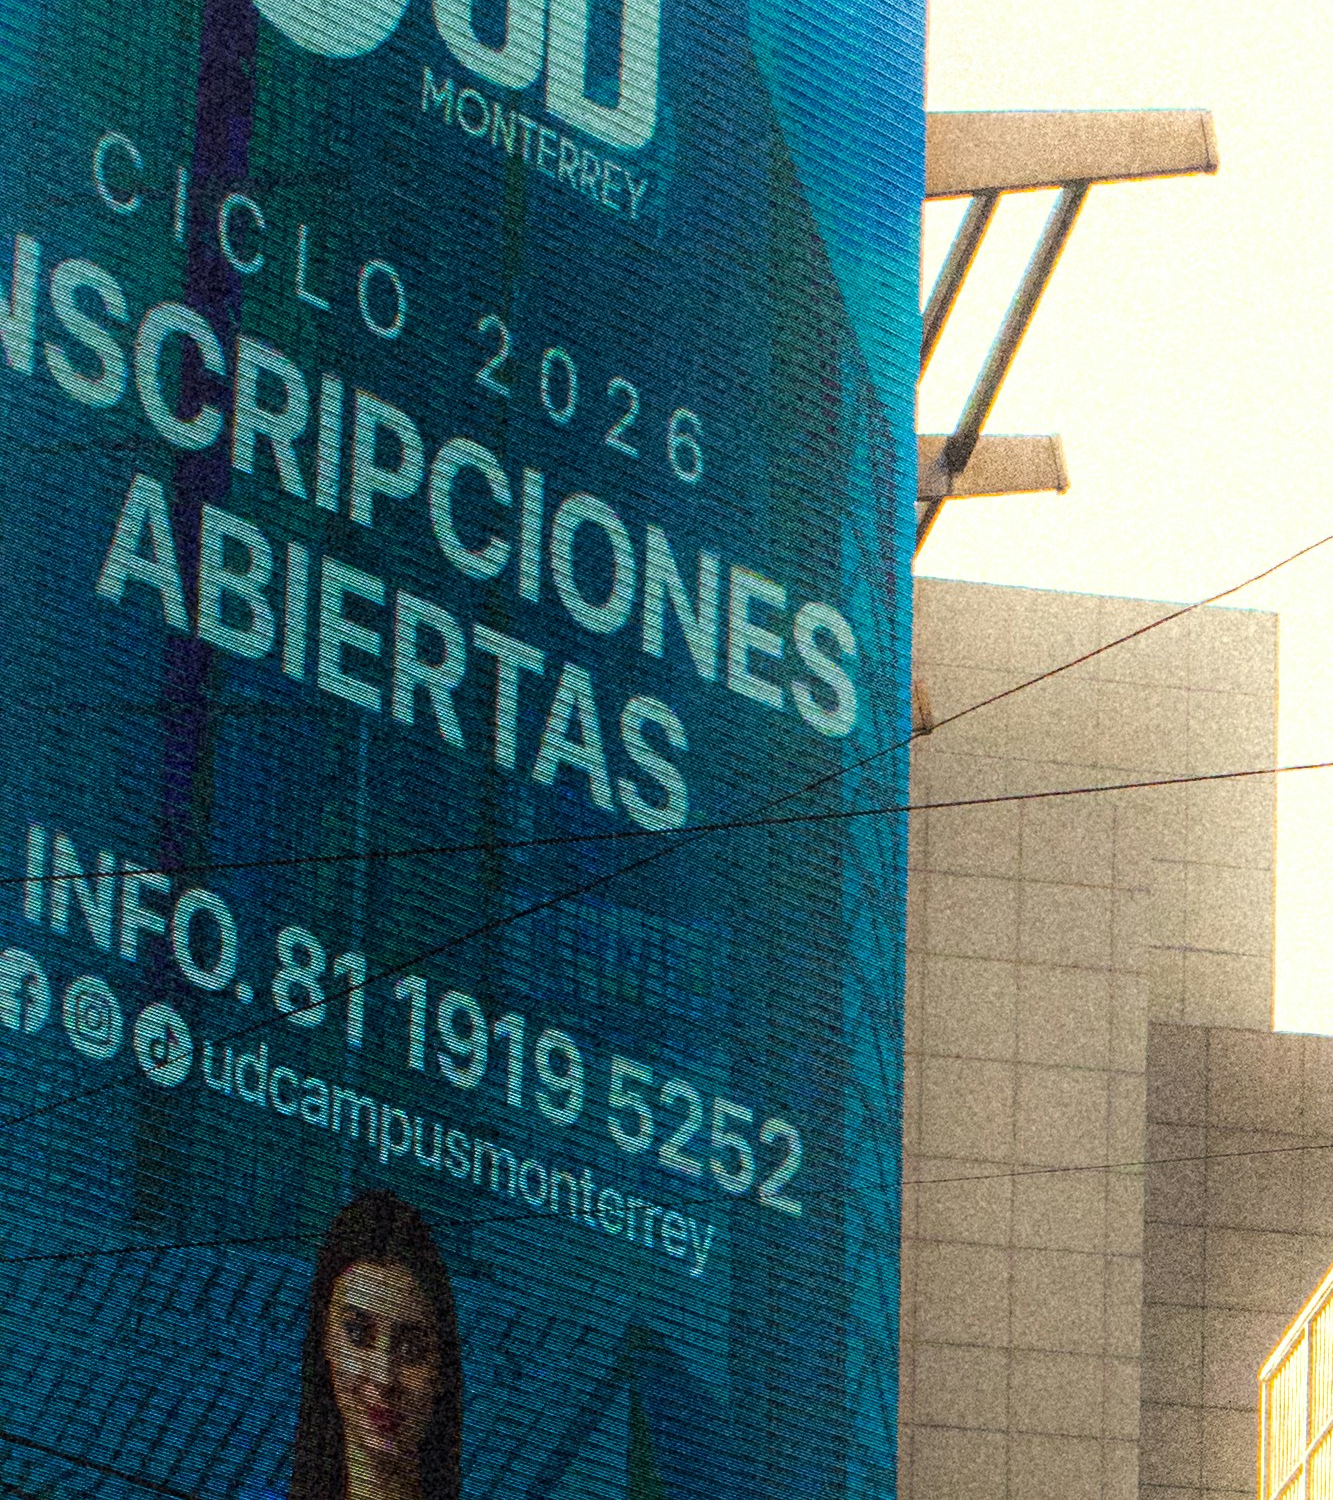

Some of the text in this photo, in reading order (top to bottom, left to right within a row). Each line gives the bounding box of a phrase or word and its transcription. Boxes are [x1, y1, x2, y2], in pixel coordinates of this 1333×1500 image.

[91, 131, 706, 487] CICLO 2026
[420, 66, 648, 219] MONTERREY
[95, 473, 692, 832] ABIERTAS
[23, 822, 806, 1217] INFO. 81 1919 5252
[201, 1039, 716, 1276] udcampusmonterrey
